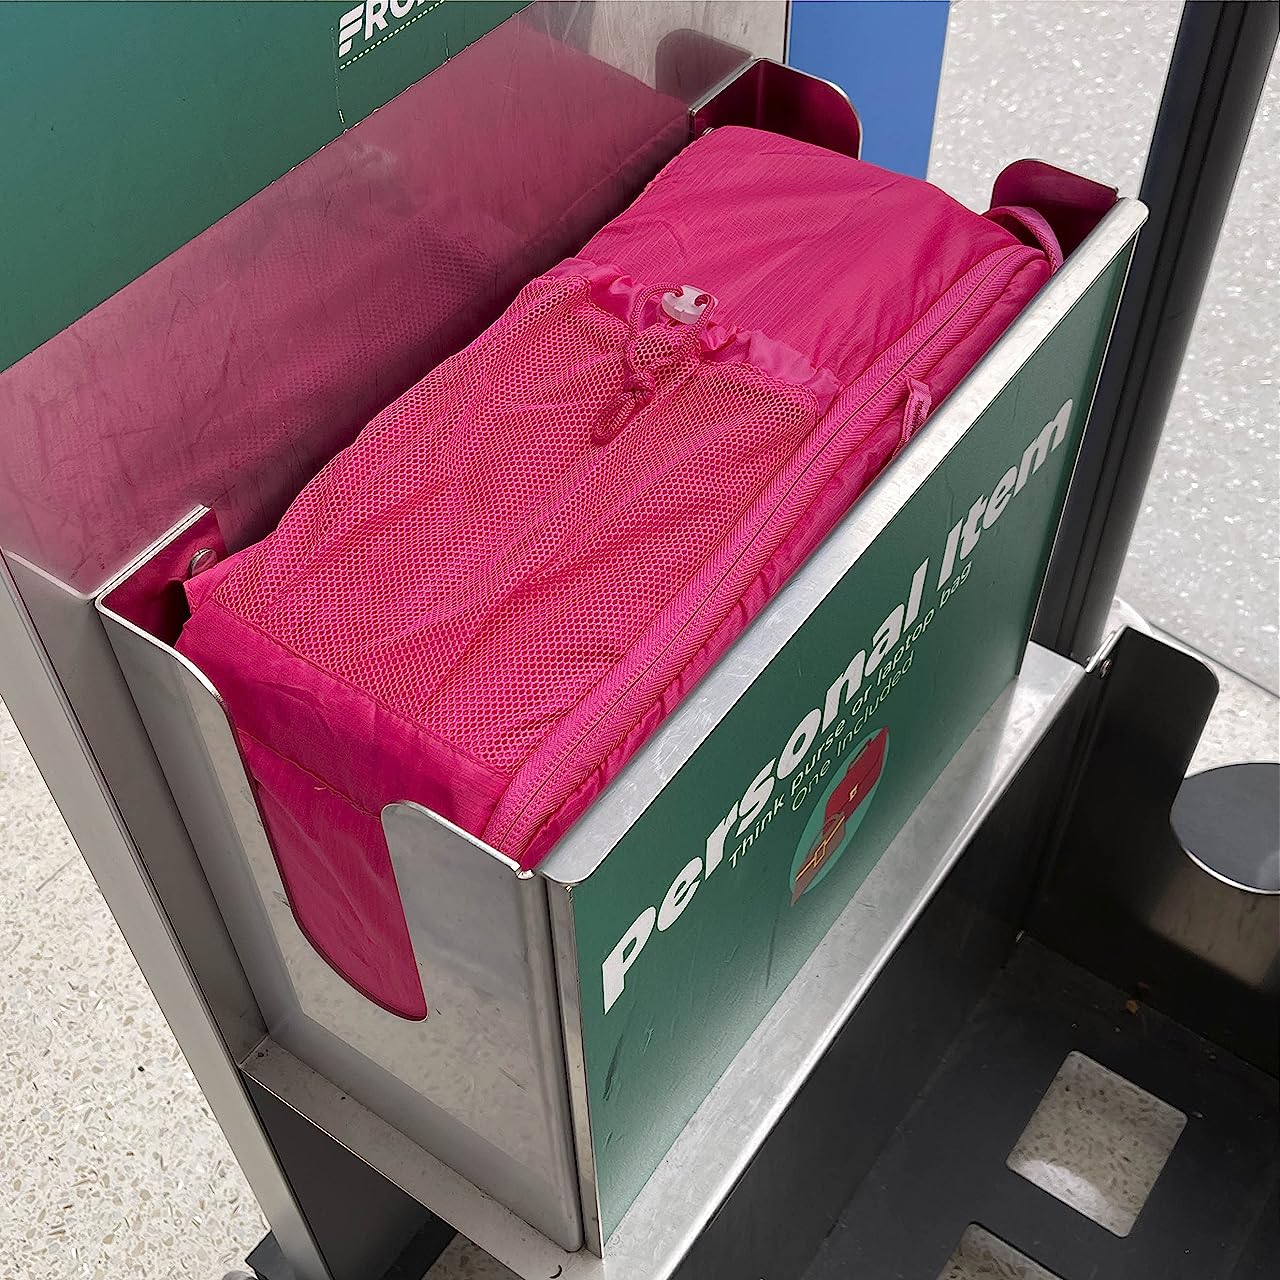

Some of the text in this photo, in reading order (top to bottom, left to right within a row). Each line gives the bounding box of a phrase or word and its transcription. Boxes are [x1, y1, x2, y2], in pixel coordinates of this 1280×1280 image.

[602, 399, 1073, 1015] Personal Item
[728, 561, 972, 869] Think purse or laptop bag
[792, 757, 832, 812] One
